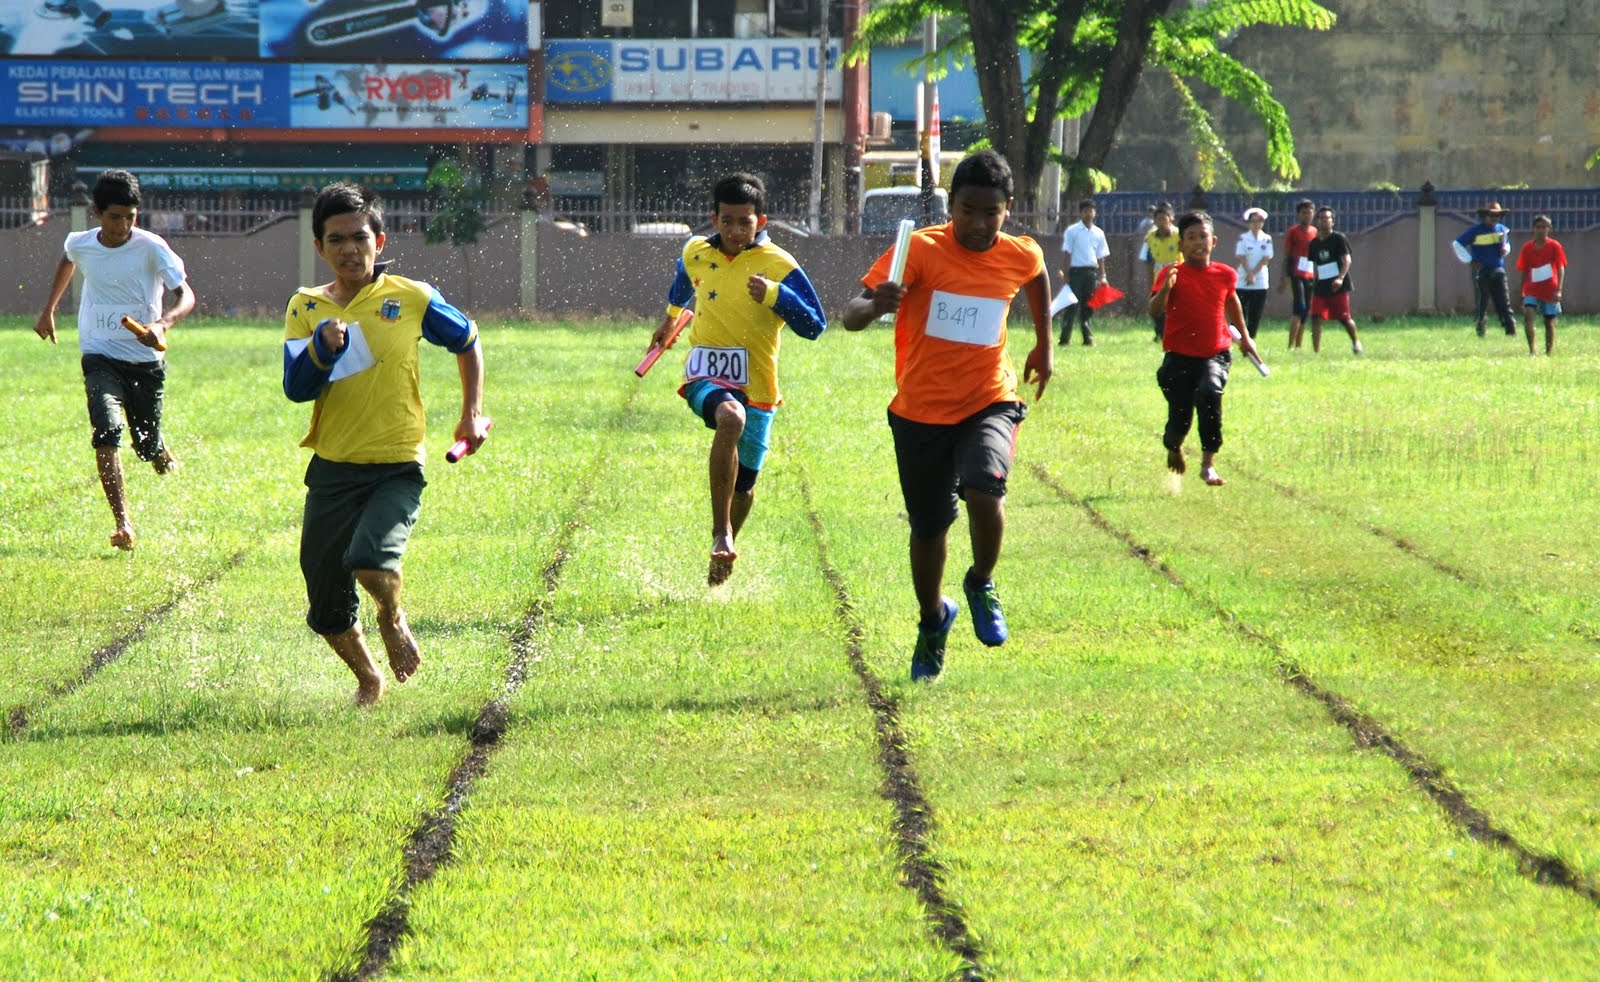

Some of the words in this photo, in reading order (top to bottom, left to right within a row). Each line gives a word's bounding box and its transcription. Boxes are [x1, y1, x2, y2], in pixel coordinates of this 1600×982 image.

[620, 47, 838, 71] SUBARU
[8, 65, 48, 79] KEDAI
[51, 65, 126, 79] PERALATAN
[129, 66, 191, 79] ELEKTRIK
[194, 67, 222, 80] DAN
[224, 67, 264, 80] MESIN
[18, 82, 124, 103] SHIN
[137, 83, 262, 104] TECH
[364, 75, 451, 101] RYOBI
[15, 107, 79, 118] ELECTRIC
[83, 107, 125, 118] TOOLS
[174, 174, 208, 186] TECH
[707, 351, 741, 380] 820
